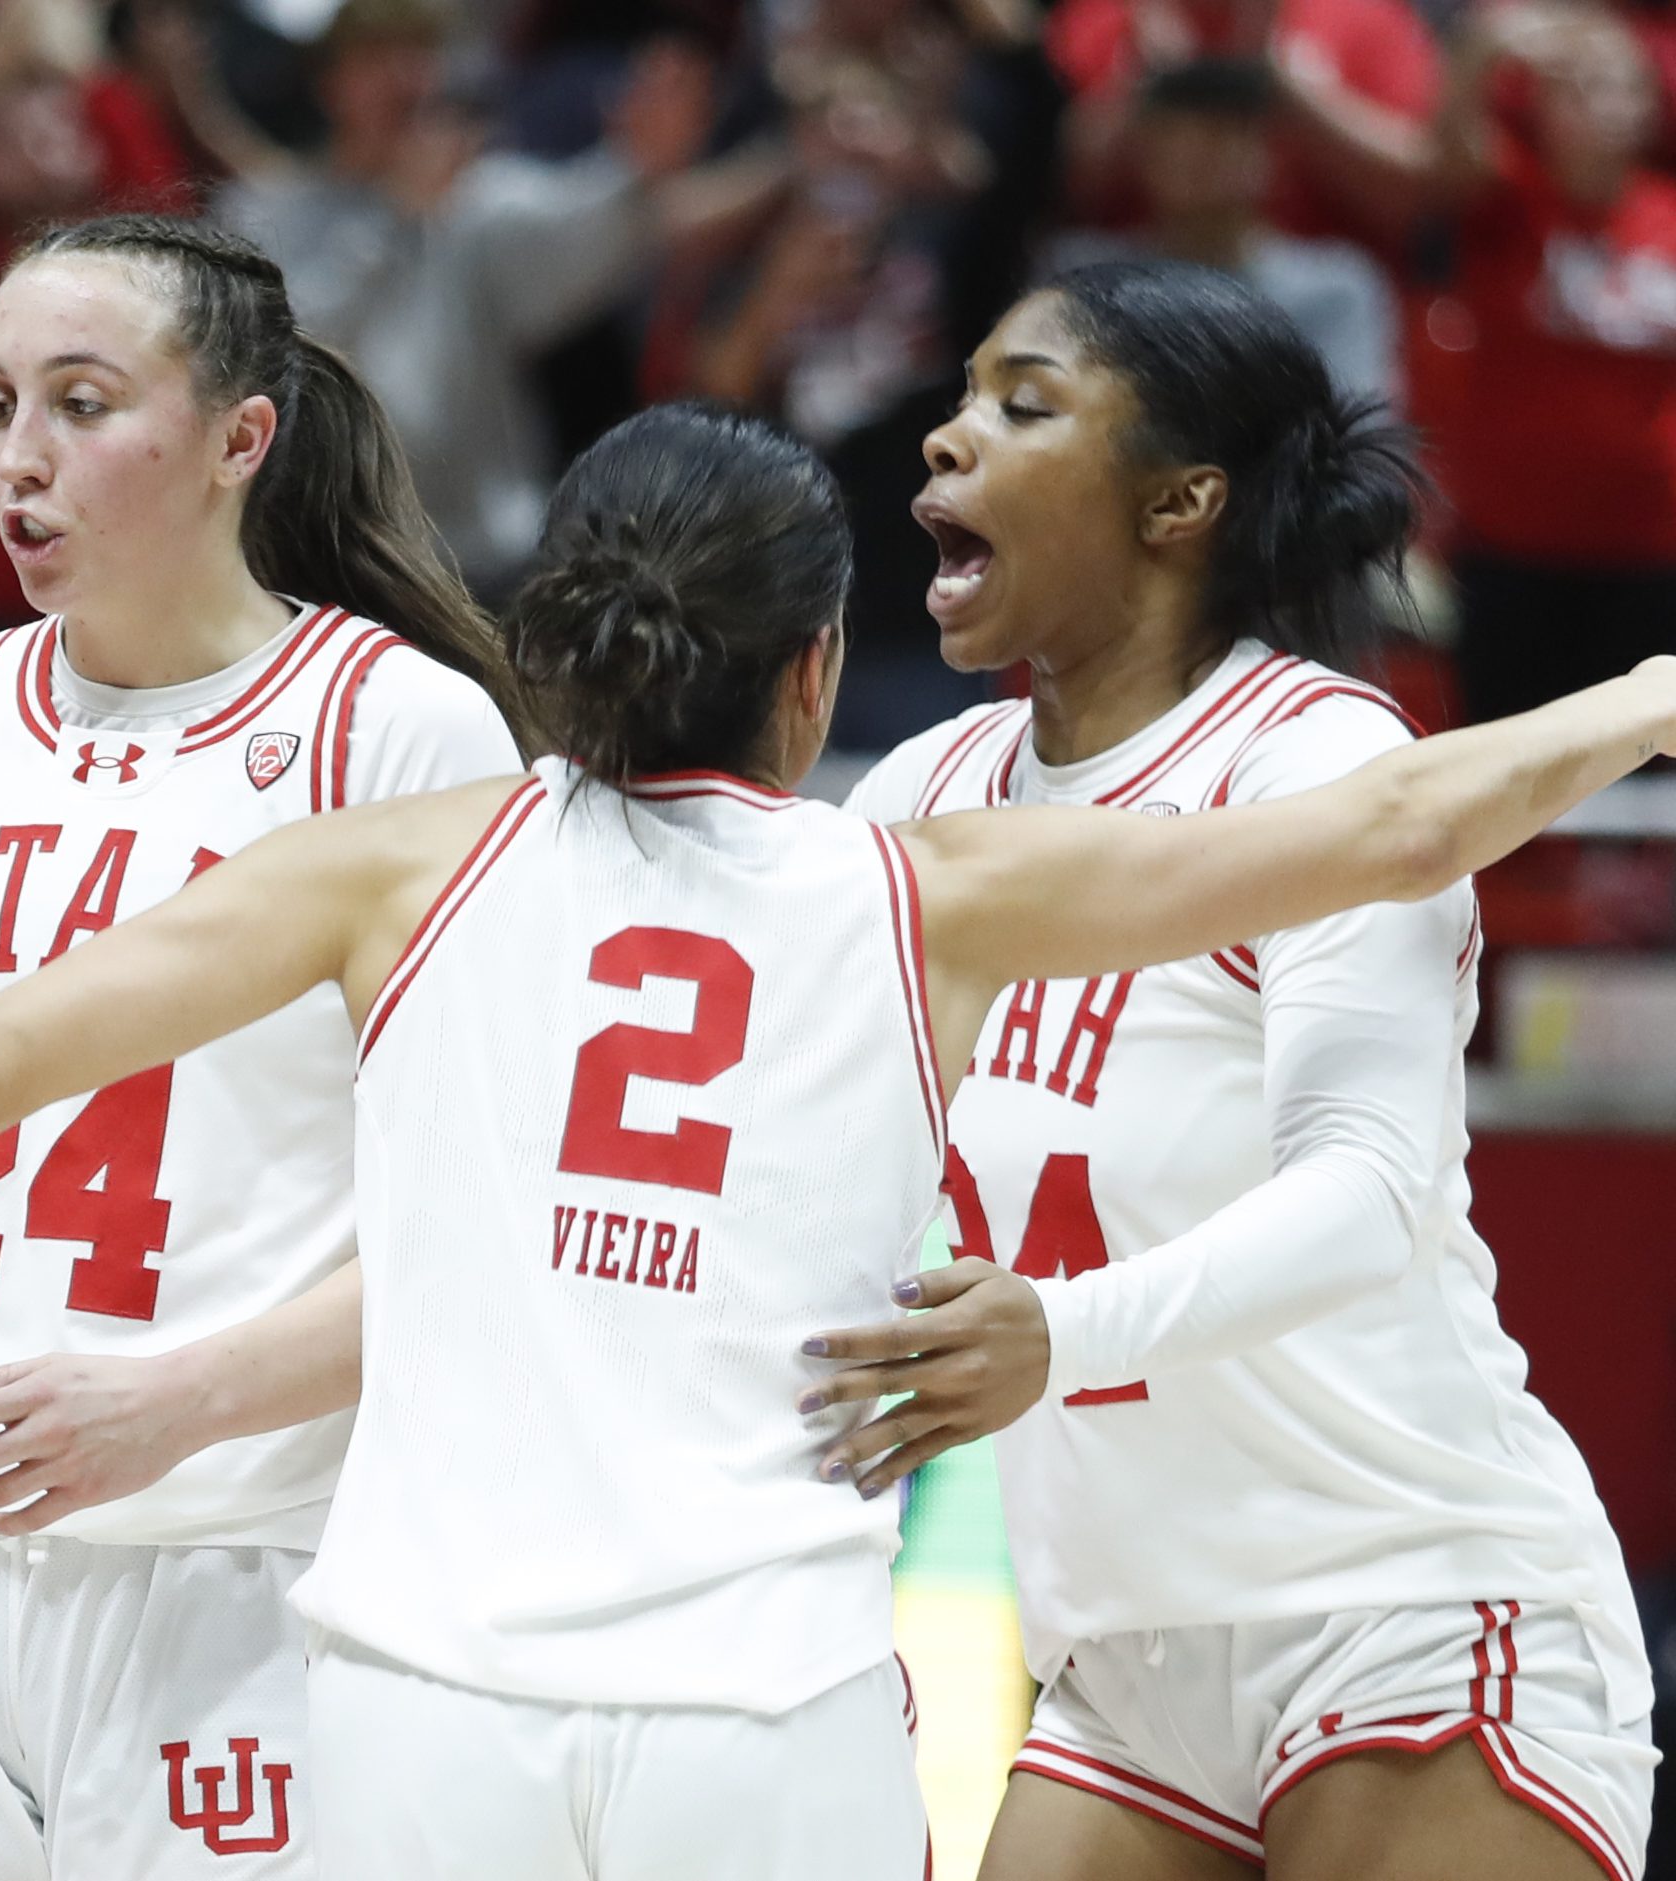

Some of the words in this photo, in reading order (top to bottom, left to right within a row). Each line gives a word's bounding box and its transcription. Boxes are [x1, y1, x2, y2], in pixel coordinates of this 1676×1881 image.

[248, 734, 298, 768] PAC
[252, 755, 280, 778] 12
[557, 925, 754, 1197] 2
[551, 1204, 701, 1293] VIEIRA
